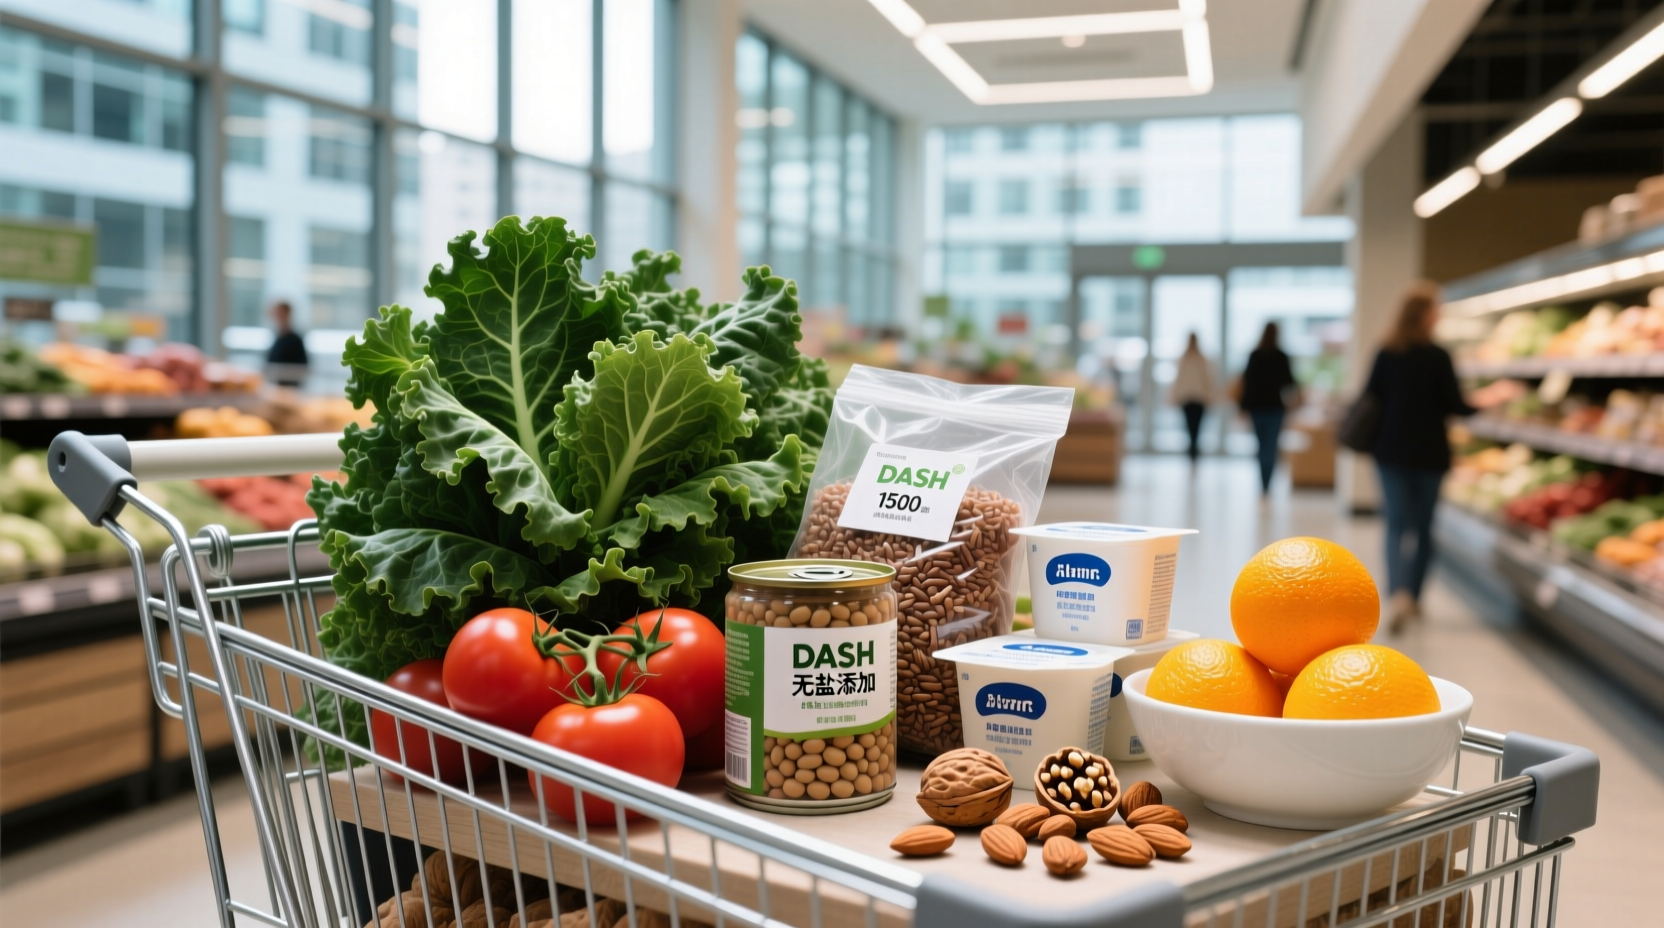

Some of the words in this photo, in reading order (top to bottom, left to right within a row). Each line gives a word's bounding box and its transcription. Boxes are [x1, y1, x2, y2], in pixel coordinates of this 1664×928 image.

[877, 464, 950, 490] DASH
[878, 491, 922, 512] 1500
[793, 640, 874, 669] DASH
[792, 672, 875, 697] 无盐添加
